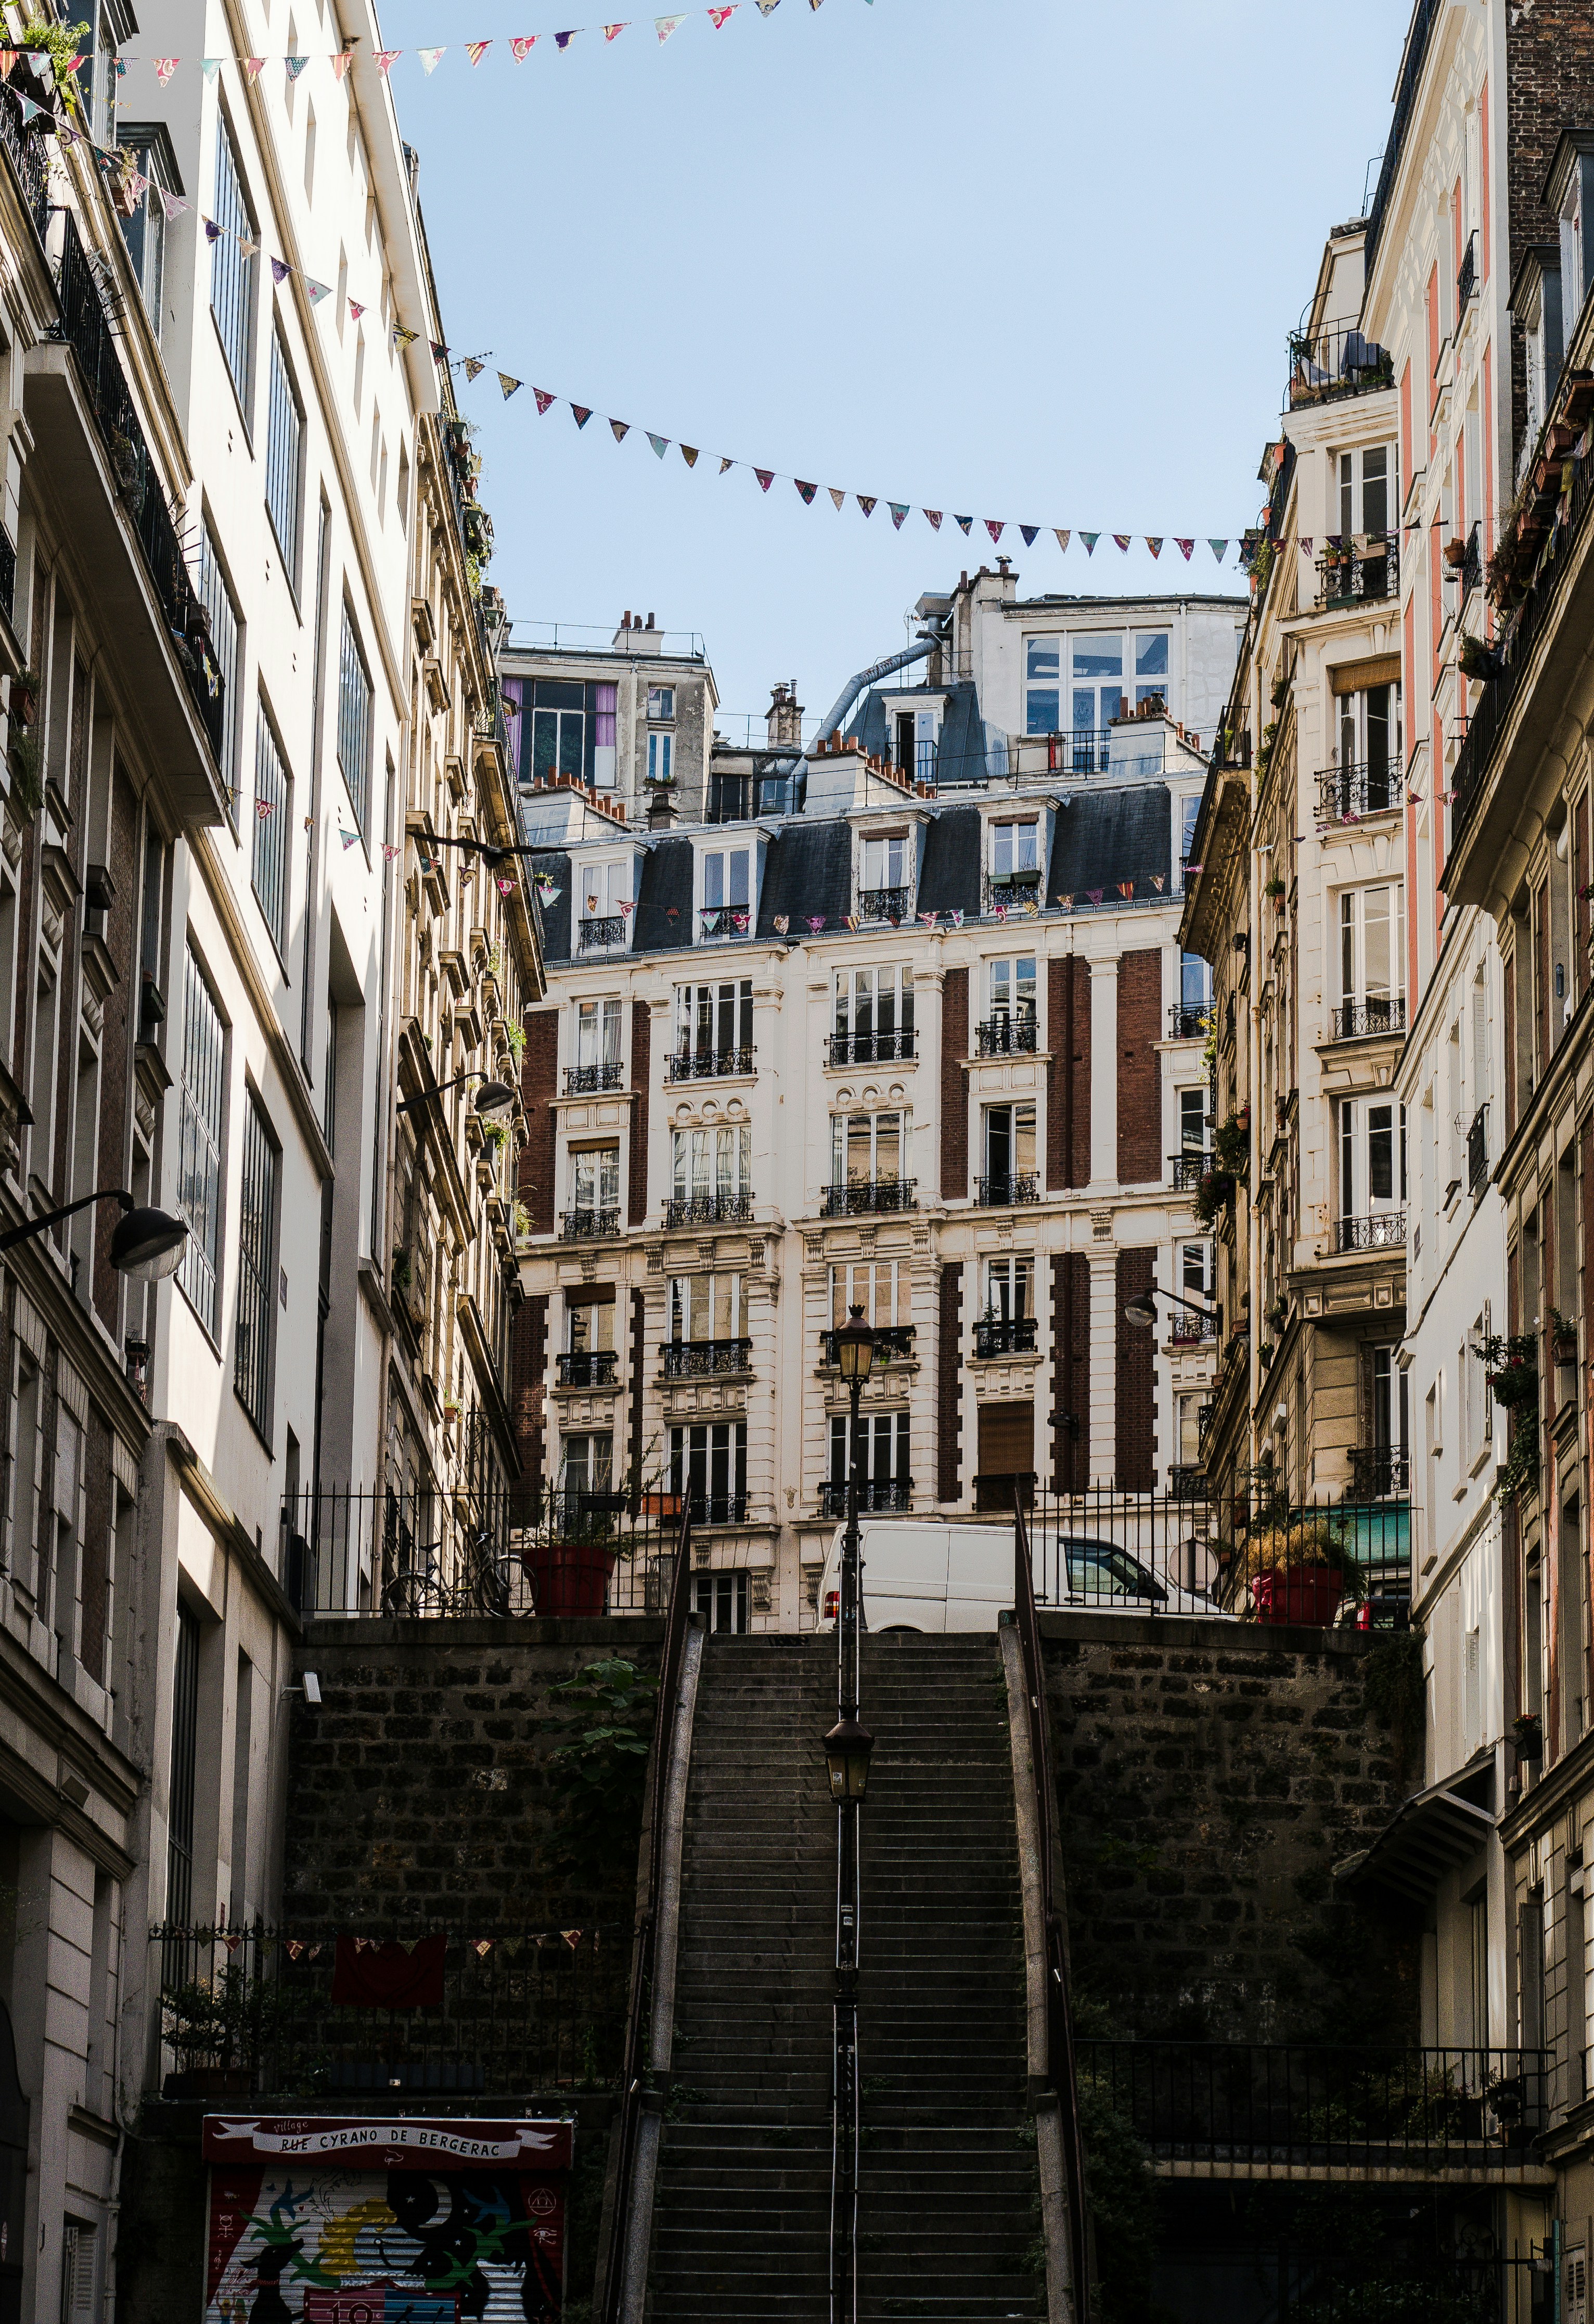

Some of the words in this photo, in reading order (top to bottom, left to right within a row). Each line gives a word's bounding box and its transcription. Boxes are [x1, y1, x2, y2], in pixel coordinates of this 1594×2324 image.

[273, 2120, 308, 2134] village
[281, 2138, 308, 2151] RUE
[320, 2130, 377, 2148] CYRANO
[391, 2130, 408, 2141] DE
[419, 2132, 499, 2156] BERGERAC
